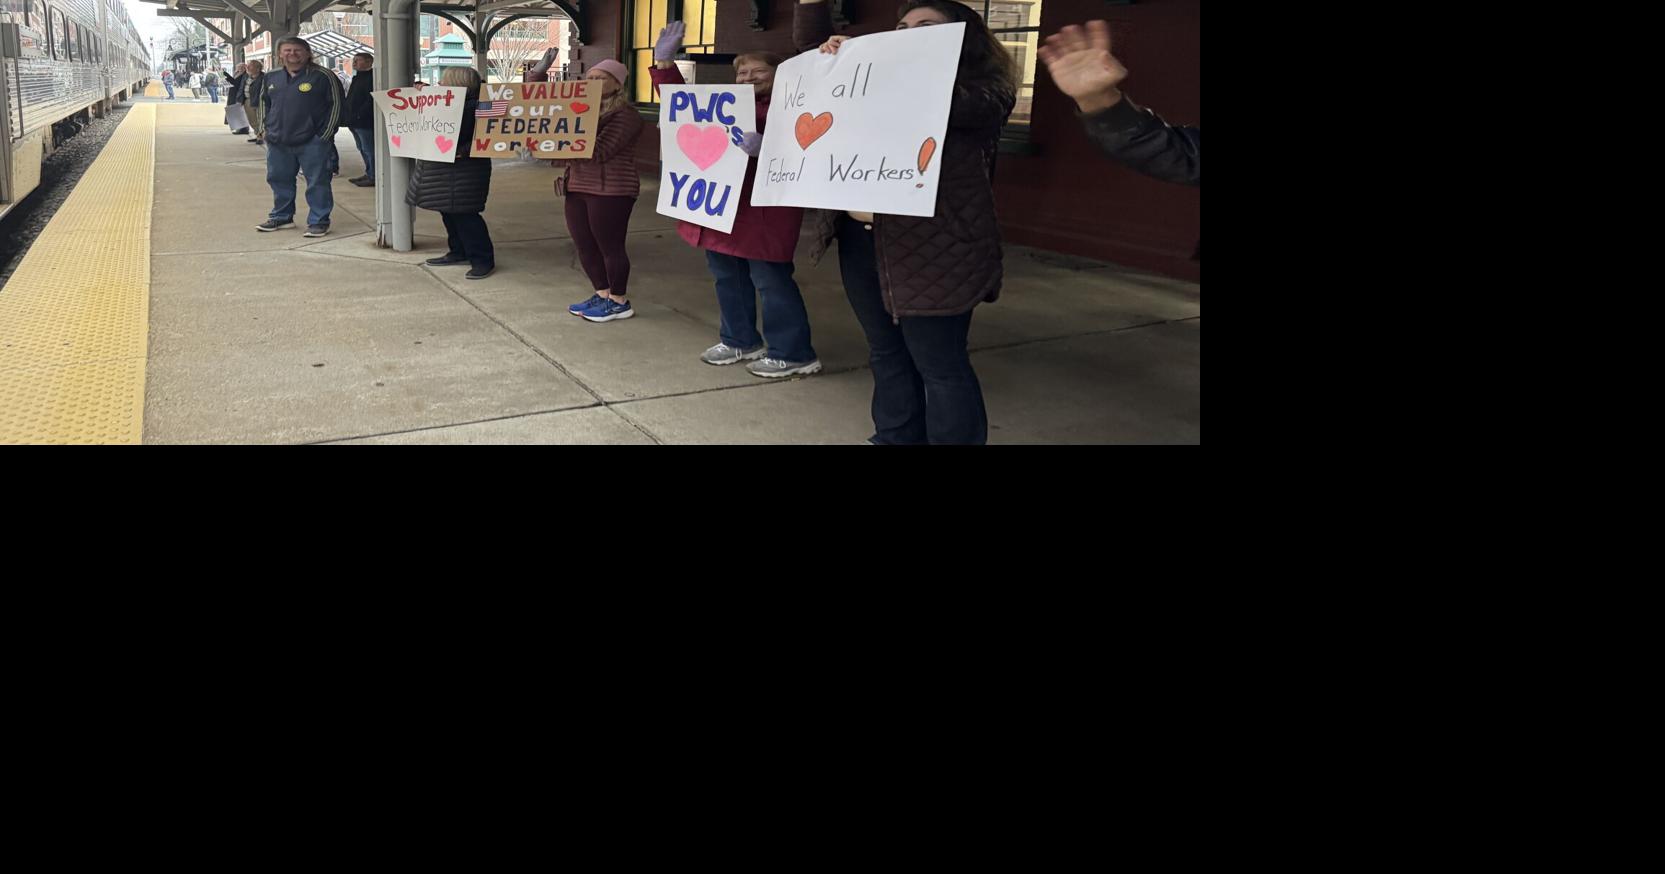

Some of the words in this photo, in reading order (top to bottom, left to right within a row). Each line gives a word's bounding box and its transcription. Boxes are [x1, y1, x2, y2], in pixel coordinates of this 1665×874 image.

[486, 84, 514, 100] We
[521, 82, 588, 100] VALUE
[784, 75, 806, 111] We
[832, 62, 873, 99] all
[509, 103, 563, 117] our
[387, 112, 421, 134] federa
[485, 116, 586, 135] FEDERAL
[765, 156, 806, 187] Federal
[669, 171, 732, 217] YOU
